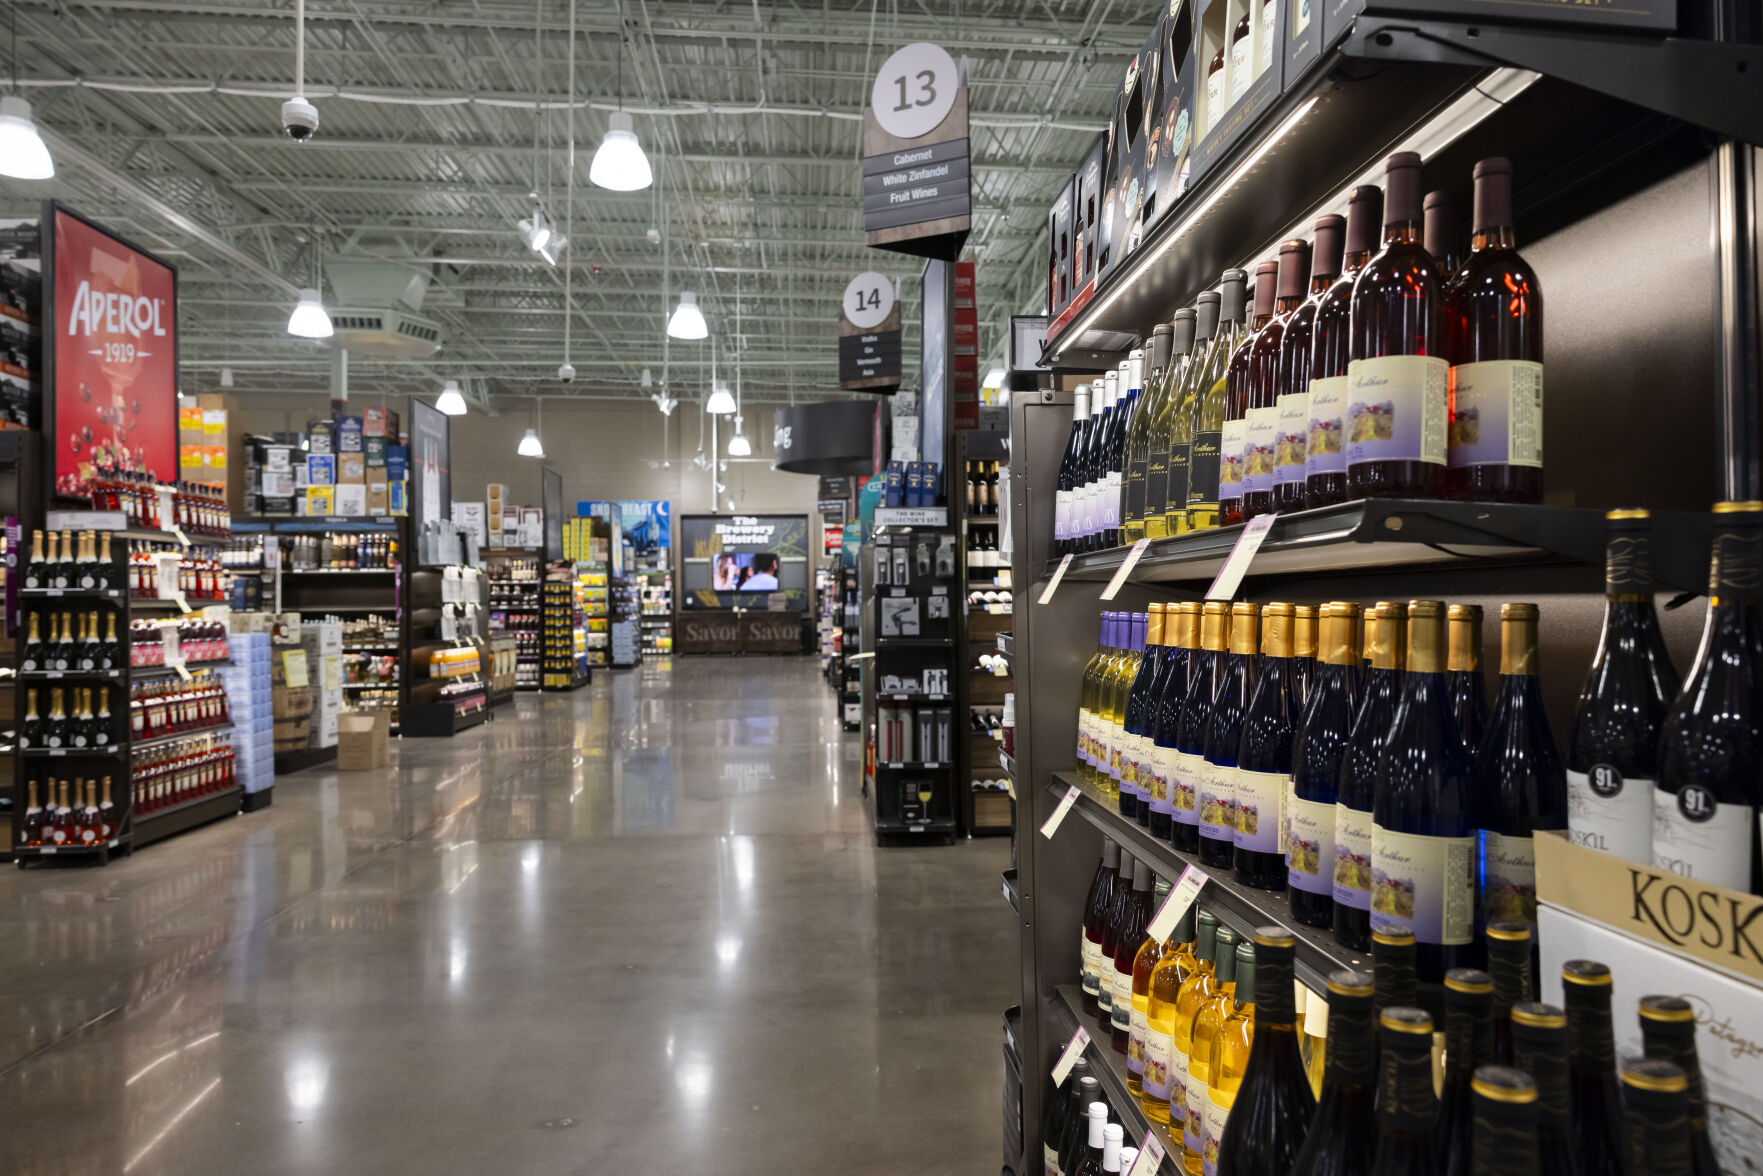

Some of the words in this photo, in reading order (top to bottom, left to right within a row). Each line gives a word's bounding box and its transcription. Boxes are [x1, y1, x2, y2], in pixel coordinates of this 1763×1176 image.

[891, 69, 938, 113] 13
[893, 149, 932, 166] Cabernet
[882, 173, 908, 187] White
[908, 164, 949, 182] Zinfandel
[890, 190, 911, 204] Fruit
[911, 187, 938, 200] Wines
[68, 280, 166, 338] APEROL
[854, 287, 881, 312] 14
[104, 342, 135, 363] 1919
[715, 524, 775, 536] Brewery
[732, 516, 758, 526] The
[721, 534, 769, 544] District
[686, 623, 738, 641] Savor
[749, 622, 800, 641] Savor
[1595, 767, 1612, 788] 91
[1685, 788, 1705, 811] 91
[1627, 868, 1763, 962] KOSK
